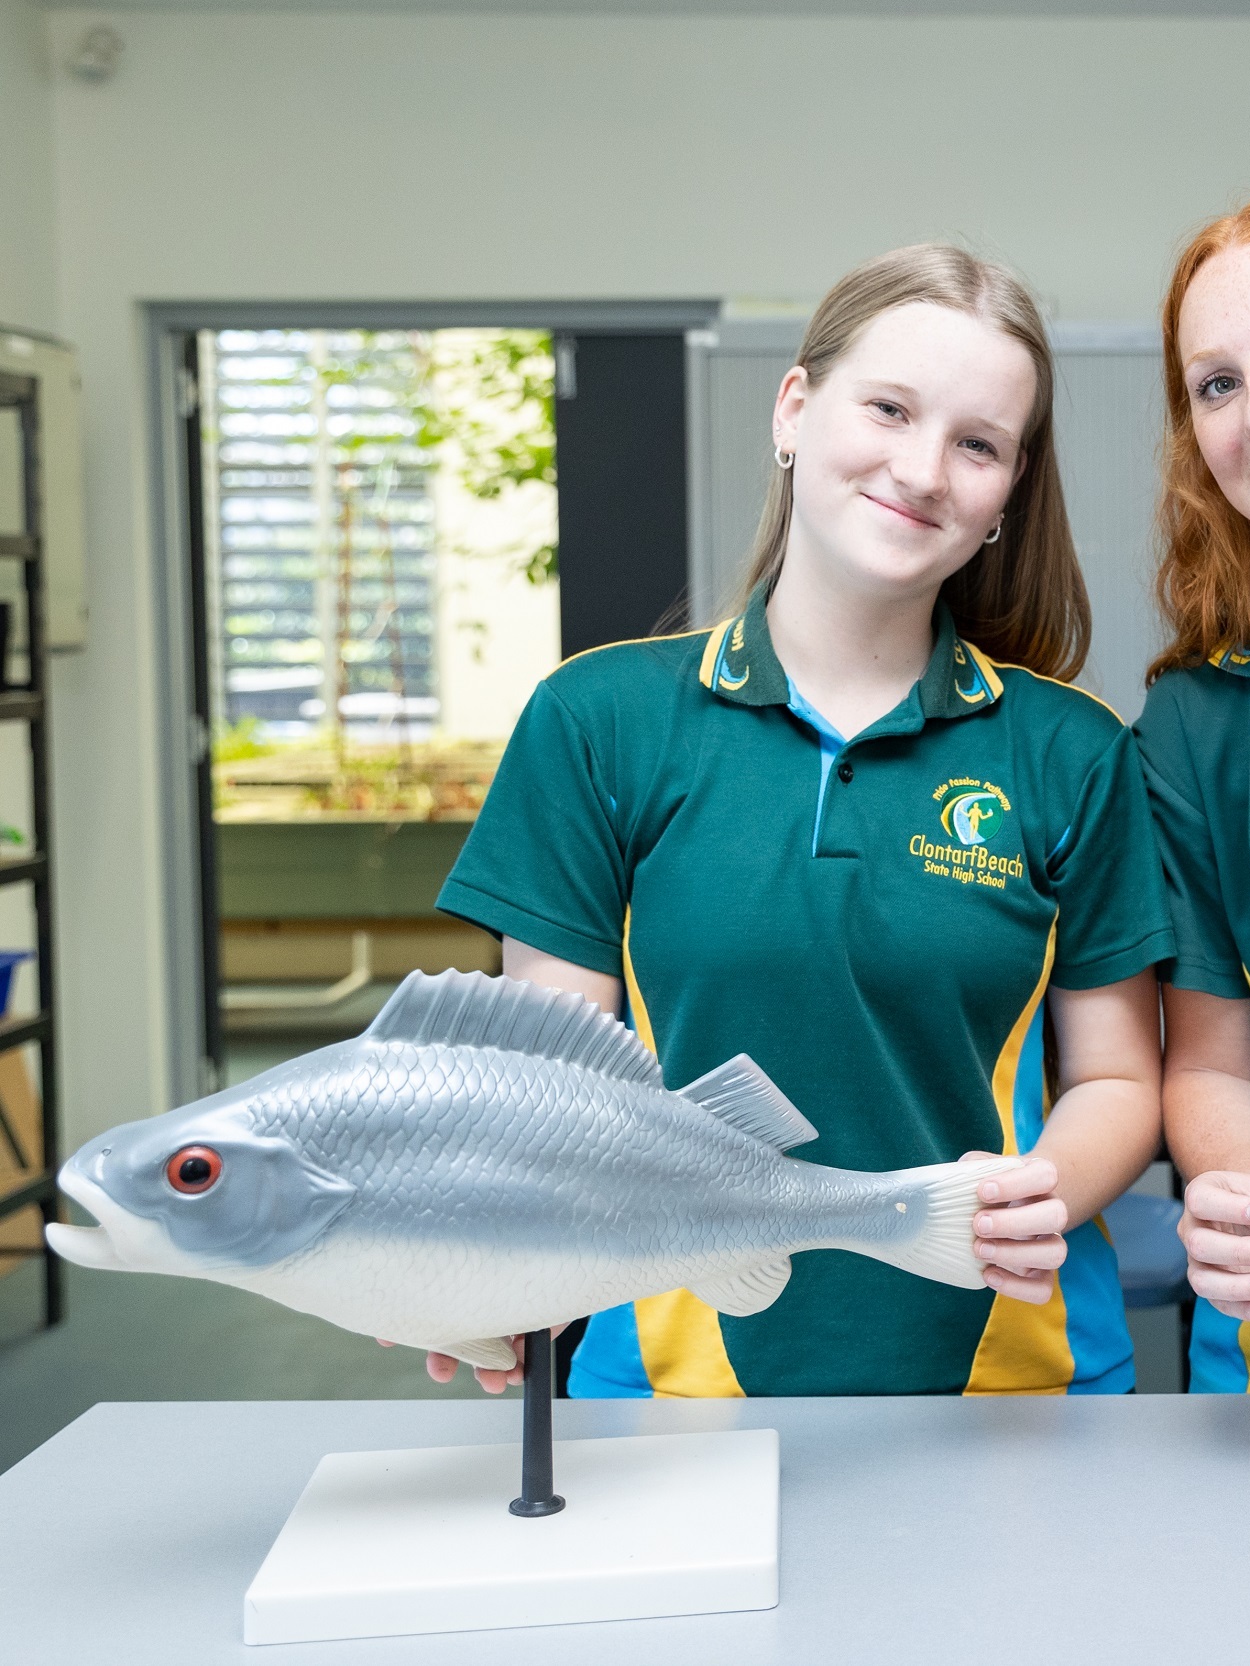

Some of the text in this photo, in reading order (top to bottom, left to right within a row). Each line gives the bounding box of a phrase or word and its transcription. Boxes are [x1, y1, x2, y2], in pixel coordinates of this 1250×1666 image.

[948, 776, 981, 788] Passion
[983, 781, 1012, 812] Pathways
[924, 860, 1007, 890] State High School
